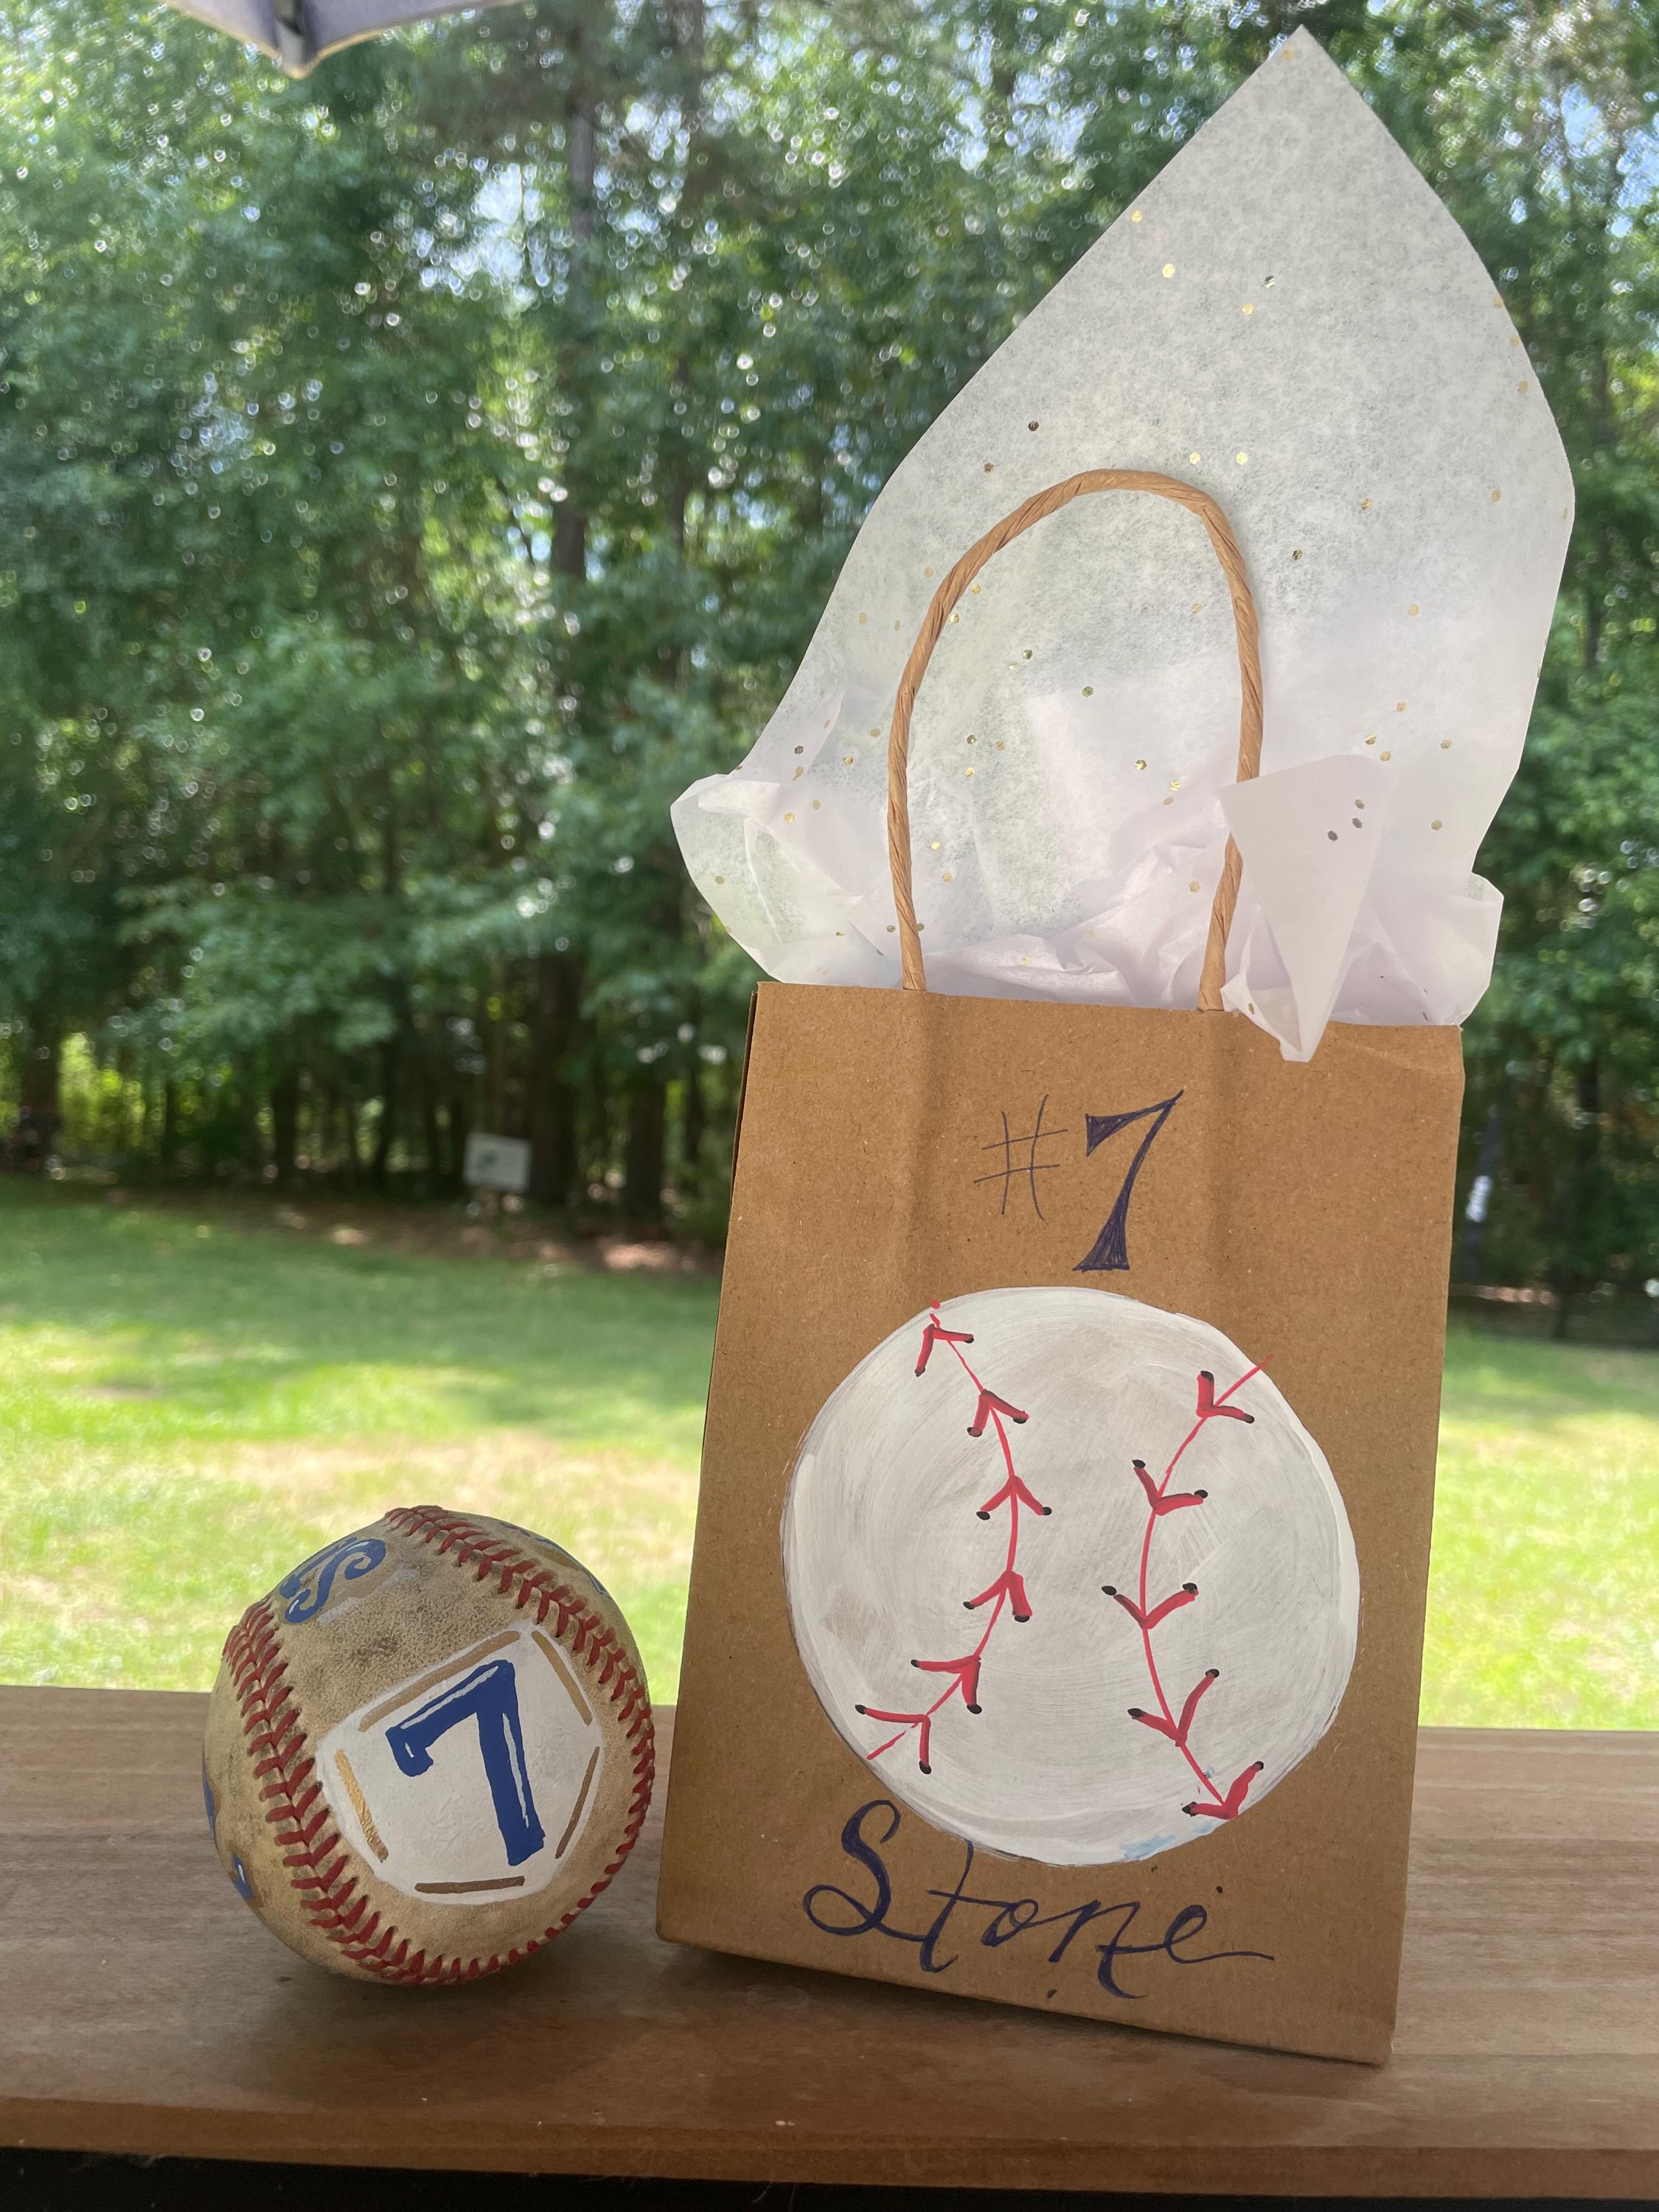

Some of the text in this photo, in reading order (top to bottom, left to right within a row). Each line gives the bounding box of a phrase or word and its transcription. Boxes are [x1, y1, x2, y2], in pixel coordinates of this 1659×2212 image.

[973, 1089, 1184, 1273] #7
[386, 1659, 546, 1866] 7
[803, 1799, 1275, 2000] Stone
